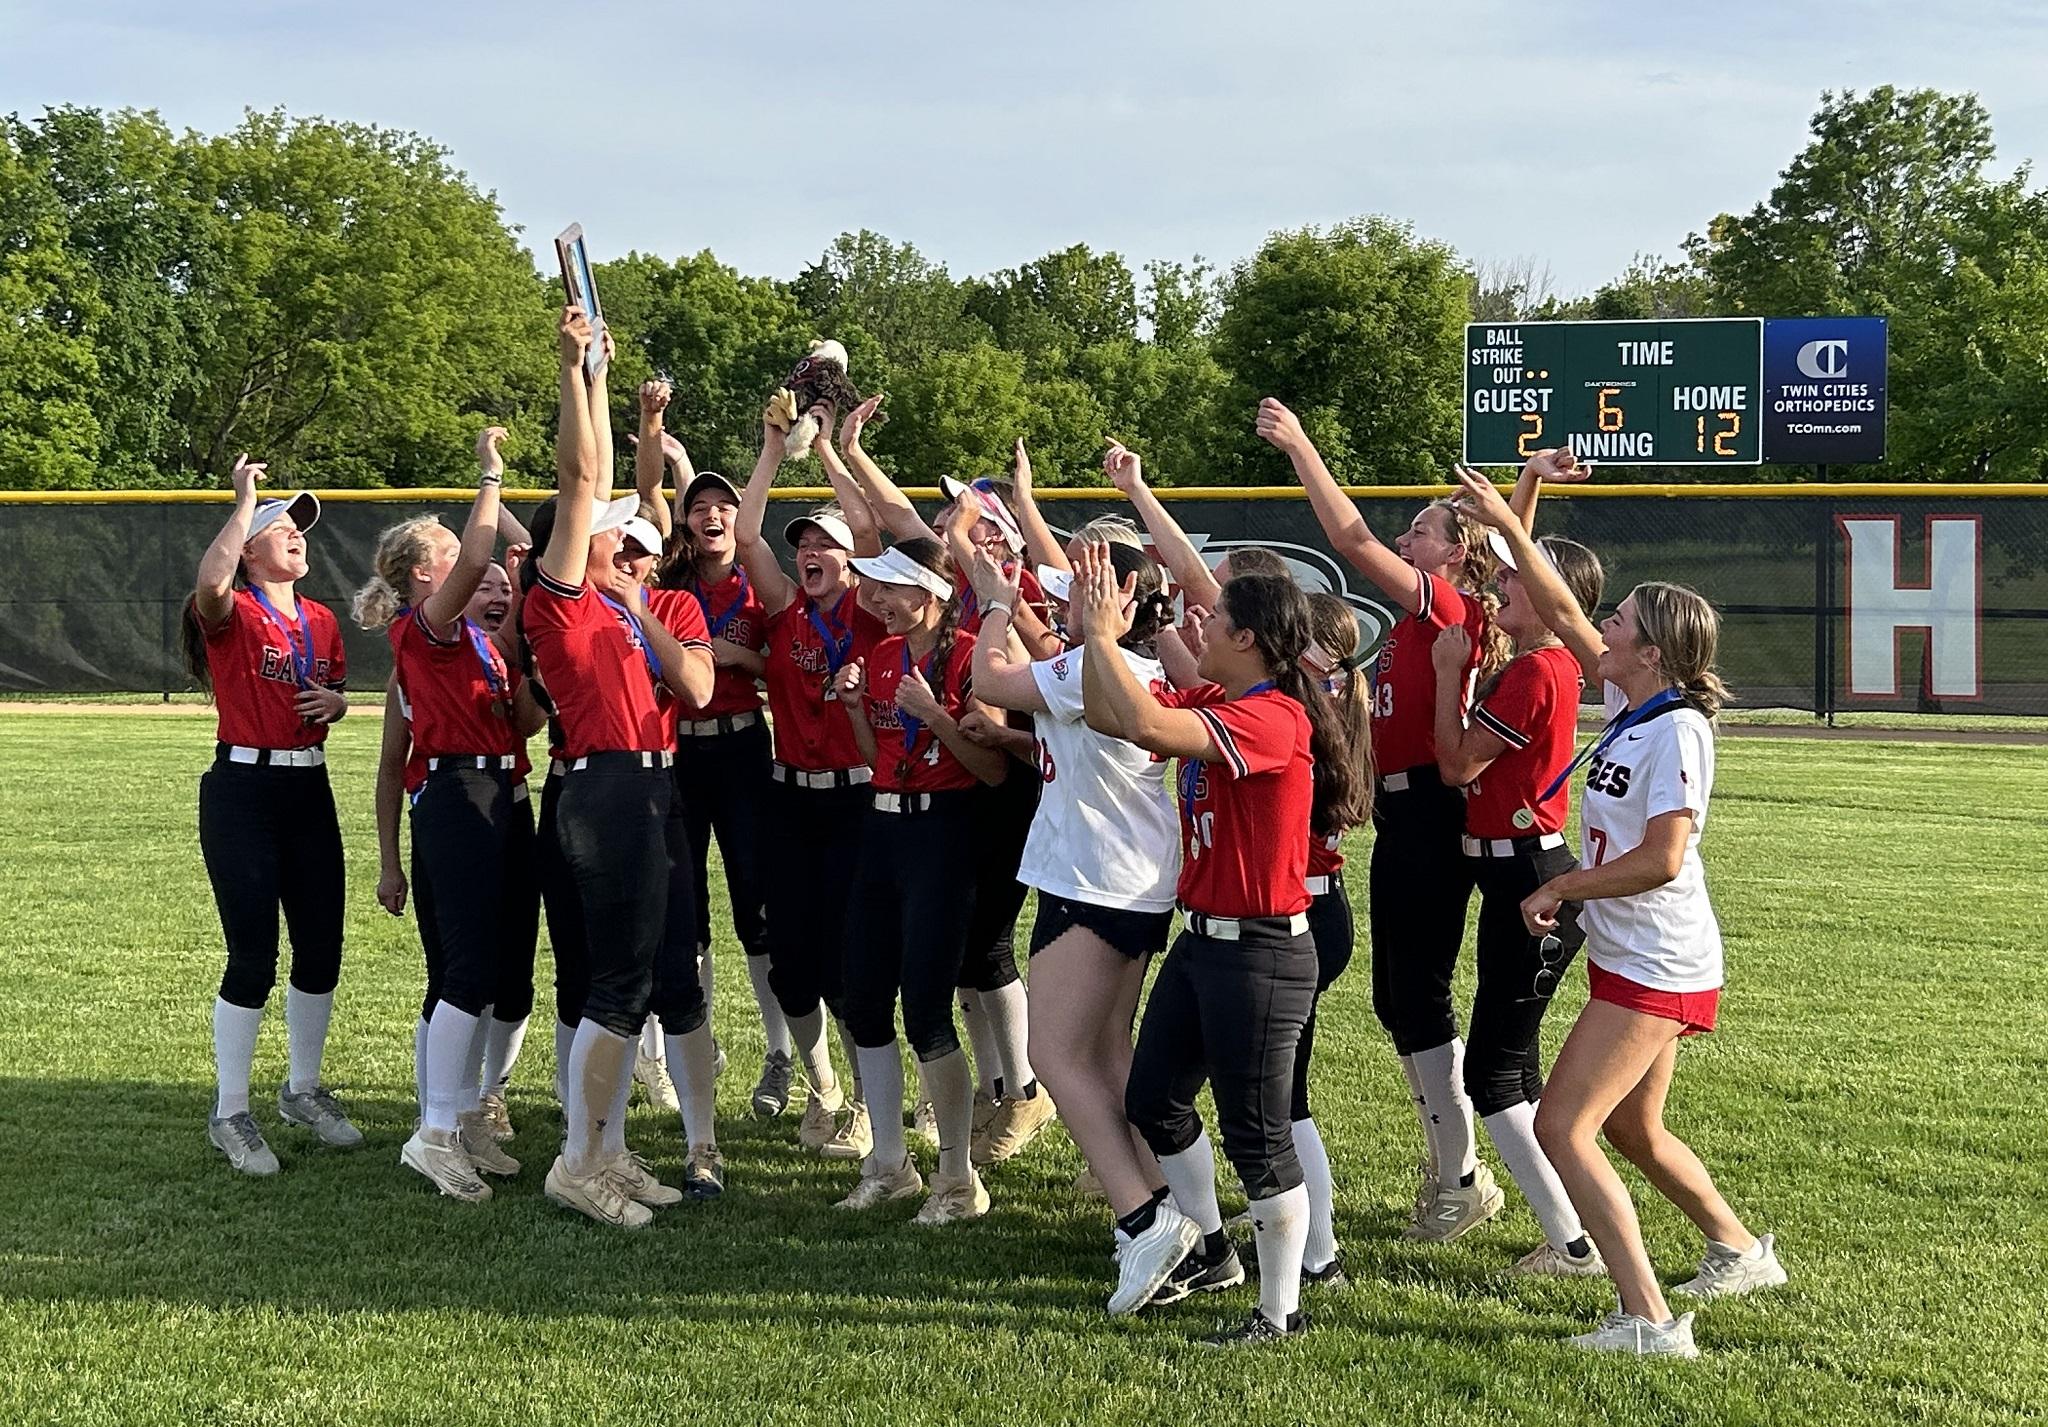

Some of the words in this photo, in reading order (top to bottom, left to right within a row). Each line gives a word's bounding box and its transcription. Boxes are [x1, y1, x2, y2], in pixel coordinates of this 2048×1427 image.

[1486, 329, 1524, 346] BALL
[1471, 348, 1524, 365] STRIKE
[1617, 341, 1674, 366] TIME
[1493, 367, 1524, 384] OUT
[1473, 388, 1554, 413] GUEST
[1673, 386, 1747, 411] HOME
[1781, 384, 1818, 398] TWIN
[1823, 383, 1868, 397] CITIES
[1597, 388, 1624, 432] 6
[1774, 399, 1875, 413] ORTHOPEDICS
[1518, 414, 1543, 457] 2
[1696, 413, 1741, 456] 12
[1786, 423, 1862, 435] TCOmn.com
[1567, 432, 1654, 457] INNING
[1834, 514, 1982, 703] H
[923, 738, 940, 766] 4
[1589, 826, 1608, 869] 7
